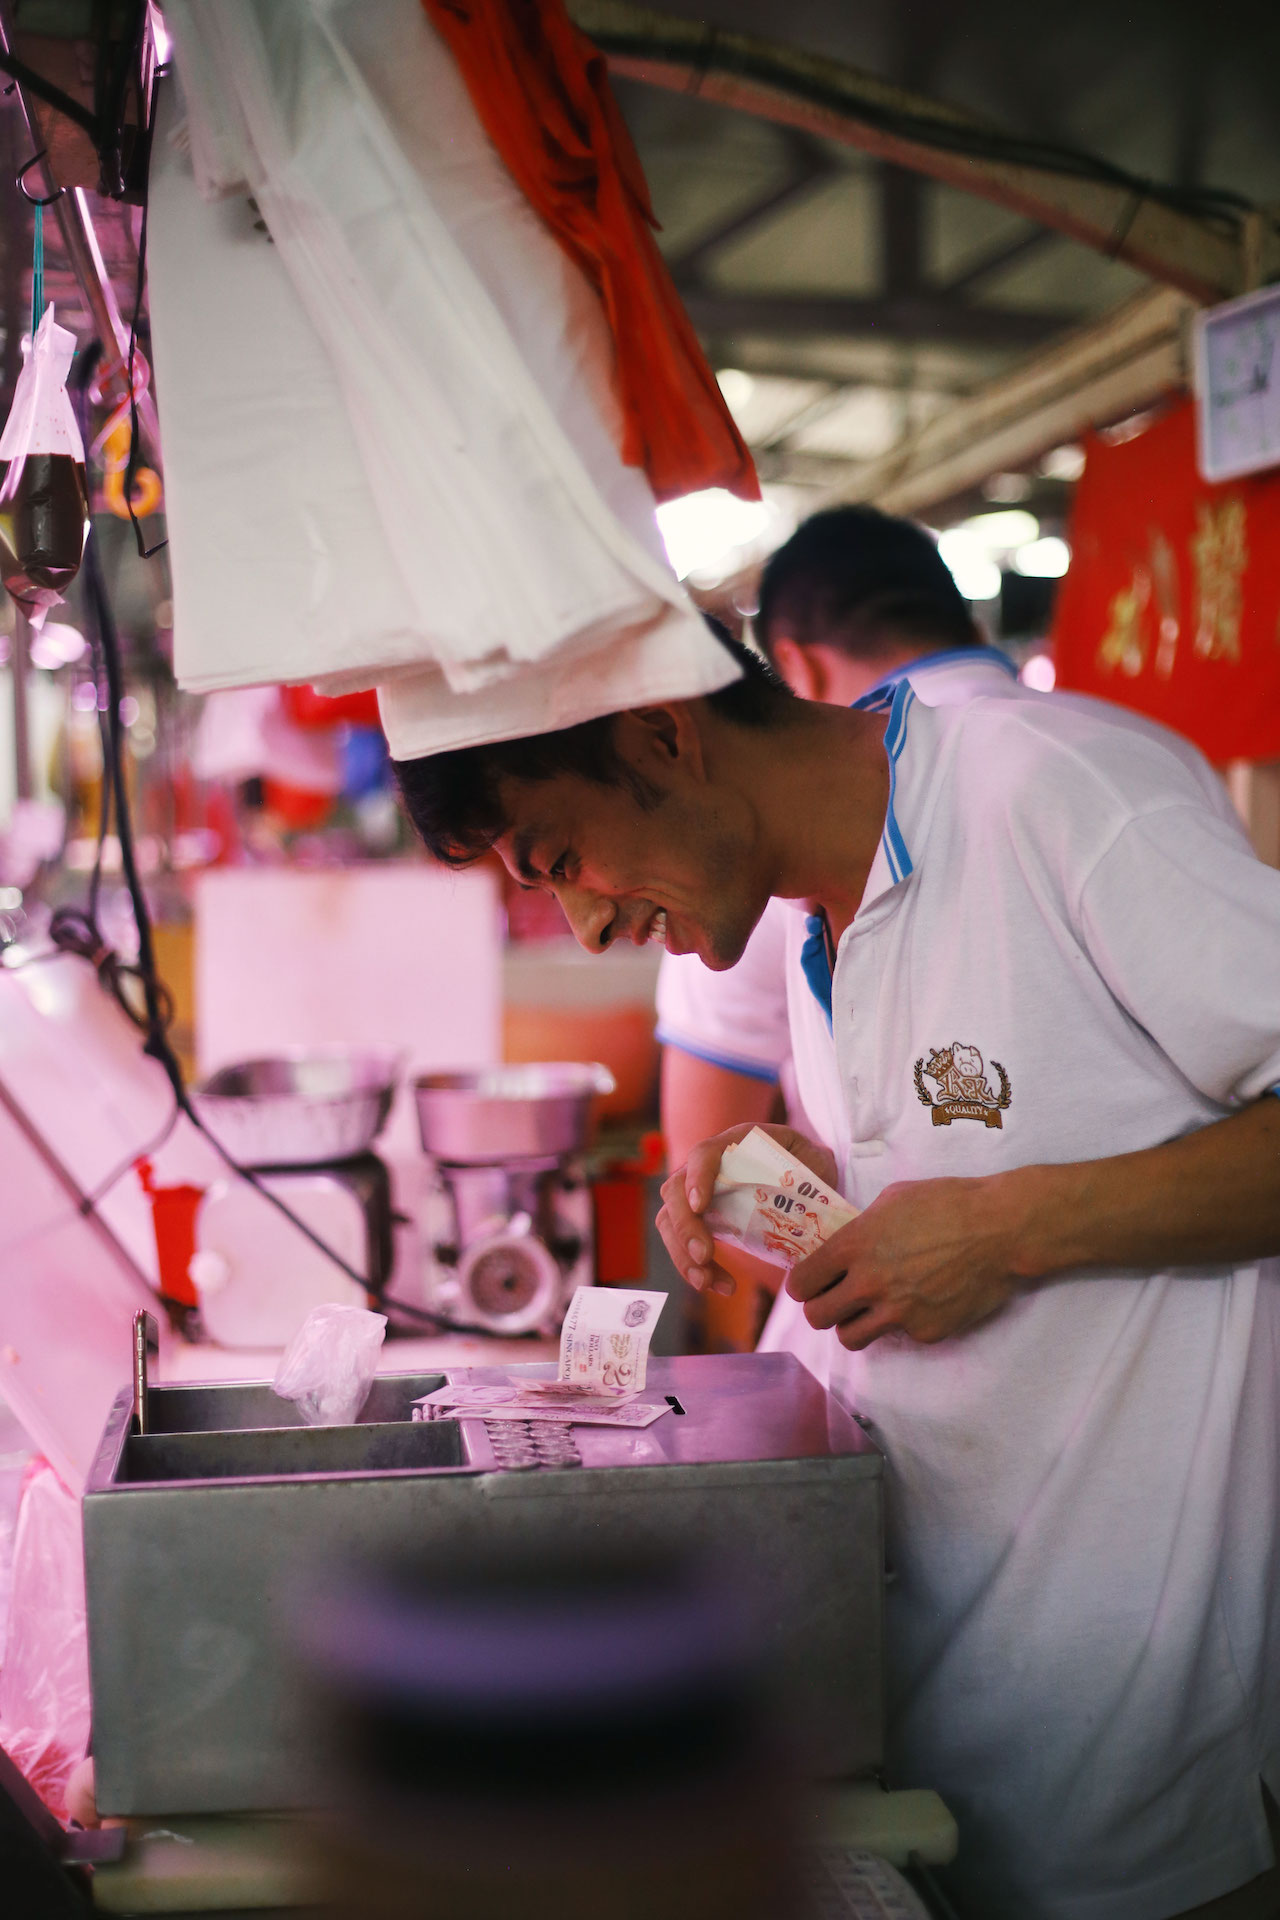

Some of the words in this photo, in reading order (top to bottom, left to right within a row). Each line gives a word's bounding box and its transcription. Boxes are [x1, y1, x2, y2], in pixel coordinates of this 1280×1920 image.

[949, 1105, 983, 1115] QUALITY
[797, 1181, 820, 1200] 10
[774, 1194, 795, 1214] 10
[602, 1361, 631, 1386] 2
